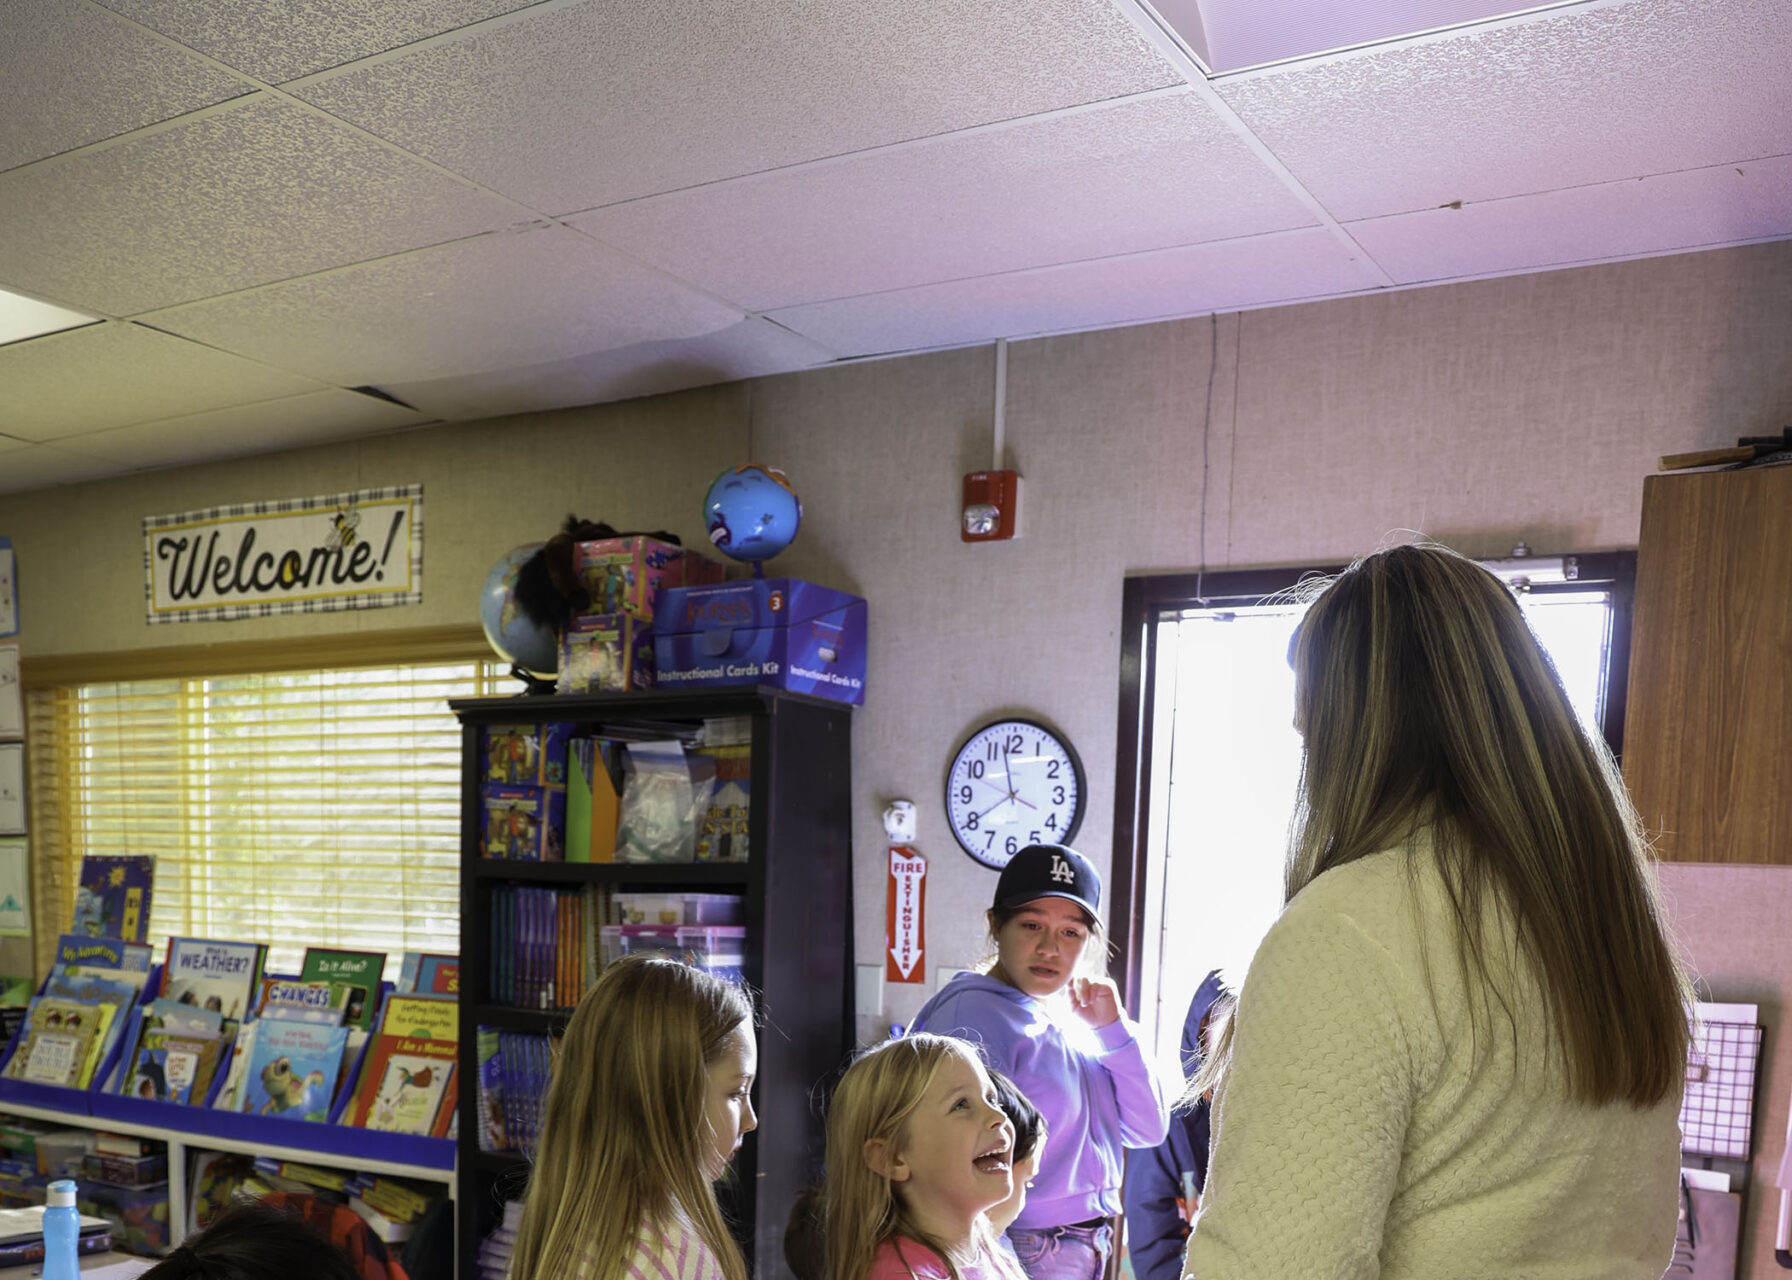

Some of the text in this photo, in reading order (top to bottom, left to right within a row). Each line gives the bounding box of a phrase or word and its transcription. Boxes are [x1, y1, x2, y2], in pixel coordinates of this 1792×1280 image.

[157, 509, 405, 601] Welcome!
[772, 597, 780, 611] 3
[657, 666, 724, 682] Instructional
[727, 662, 760, 677] Cards
[762, 661, 780, 675] Kit
[790, 665, 862, 689] Instructional Cards Kit
[987, 741, 999, 761] 11
[1006, 735, 1024, 754] 12
[1036, 741, 1040, 757] 1
[968, 760, 985, 779] 10
[1046, 760, 1060, 779] 2
[960, 785, 973, 804] 9
[1052, 785, 1065, 805] 3
[966, 811, 980, 831] 8
[1044, 813, 1058, 832] 4
[984, 830, 996, 850] 7
[1005, 836, 1018, 855] 6
[1029, 831, 1041, 844] 5
[893, 862, 923, 873] FIRE
[1050, 855, 1074, 884] LA
[902, 875, 912, 970] EXTINGUISHER
[180, 952, 249, 974] WEATHER?
[339, 960, 368, 973] Alive?
[269, 985, 330, 1007] CHANGES
